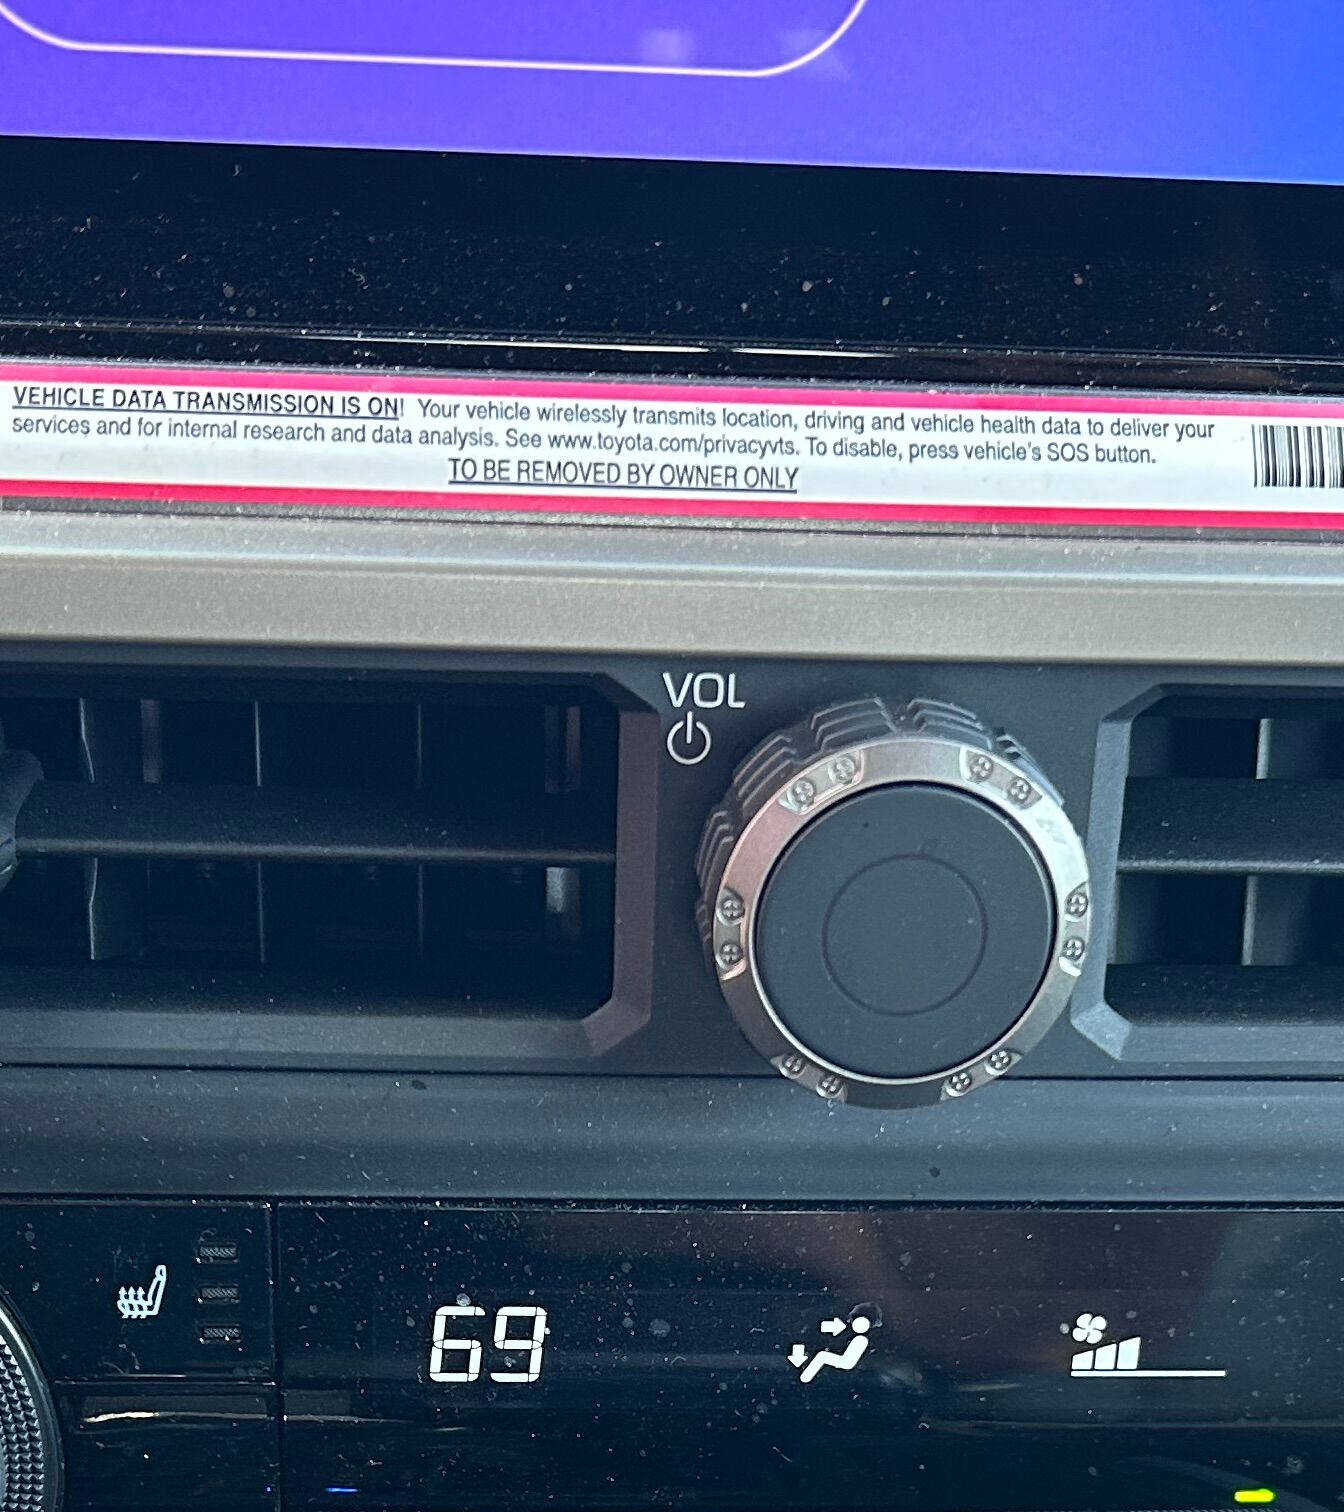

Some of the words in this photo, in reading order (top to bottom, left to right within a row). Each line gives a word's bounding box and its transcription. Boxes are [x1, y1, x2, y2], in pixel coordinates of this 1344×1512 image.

[14, 386, 105, 409] VEHICLE
[112, 389, 166, 411] DATA
[172, 390, 334, 416] TRANSMISSION
[342, 396, 361, 417] IS
[367, 396, 405, 419] ON!
[418, 398, 460, 420] Your
[466, 400, 531, 421] vehicle
[537, 402, 627, 427] wirelessly
[633, 406, 716, 427] transmits
[722, 408, 798, 432] location,
[805, 410, 865, 434] driving
[871, 412, 905, 431] and
[910, 413, 974, 433] vehicle
[980, 415, 1036, 435] health
[1042, 416, 1081, 436] data
[1087, 418, 1104, 437] to
[1110, 418, 1170, 439] deliver
[1175, 422, 1215, 442] your
[12, 415, 90, 435] services
[96, 416, 131, 436] and
[137, 417, 163, 437] for
[168, 418, 237, 439] internal
[243, 420, 325, 441] research
[331, 424, 366, 444] and
[371, 425, 413, 445] data
[419, 427, 499, 451] analysis.
[505, 428, 542, 449] See
[547, 430, 800, 460] www.toyota.com/privacyvts.
[805, 436, 827, 457] To
[833, 437, 903, 462] disable,
[908, 442, 958, 464] press
[964, 441, 1041, 462] vehicle's
[1047, 443, 1089, 462] SOS
[1095, 443, 1157, 465] button.
[448, 457, 477, 482] TO
[484, 459, 511, 483] BE
[517, 460, 620, 486] REMOVED
[627, 463, 654, 487] BY
[660, 464, 738, 489] OWNER
[744, 466, 798, 491] ONLY
[662, 672, 746, 708] VOL
[429, 1305, 548, 1384] 69
